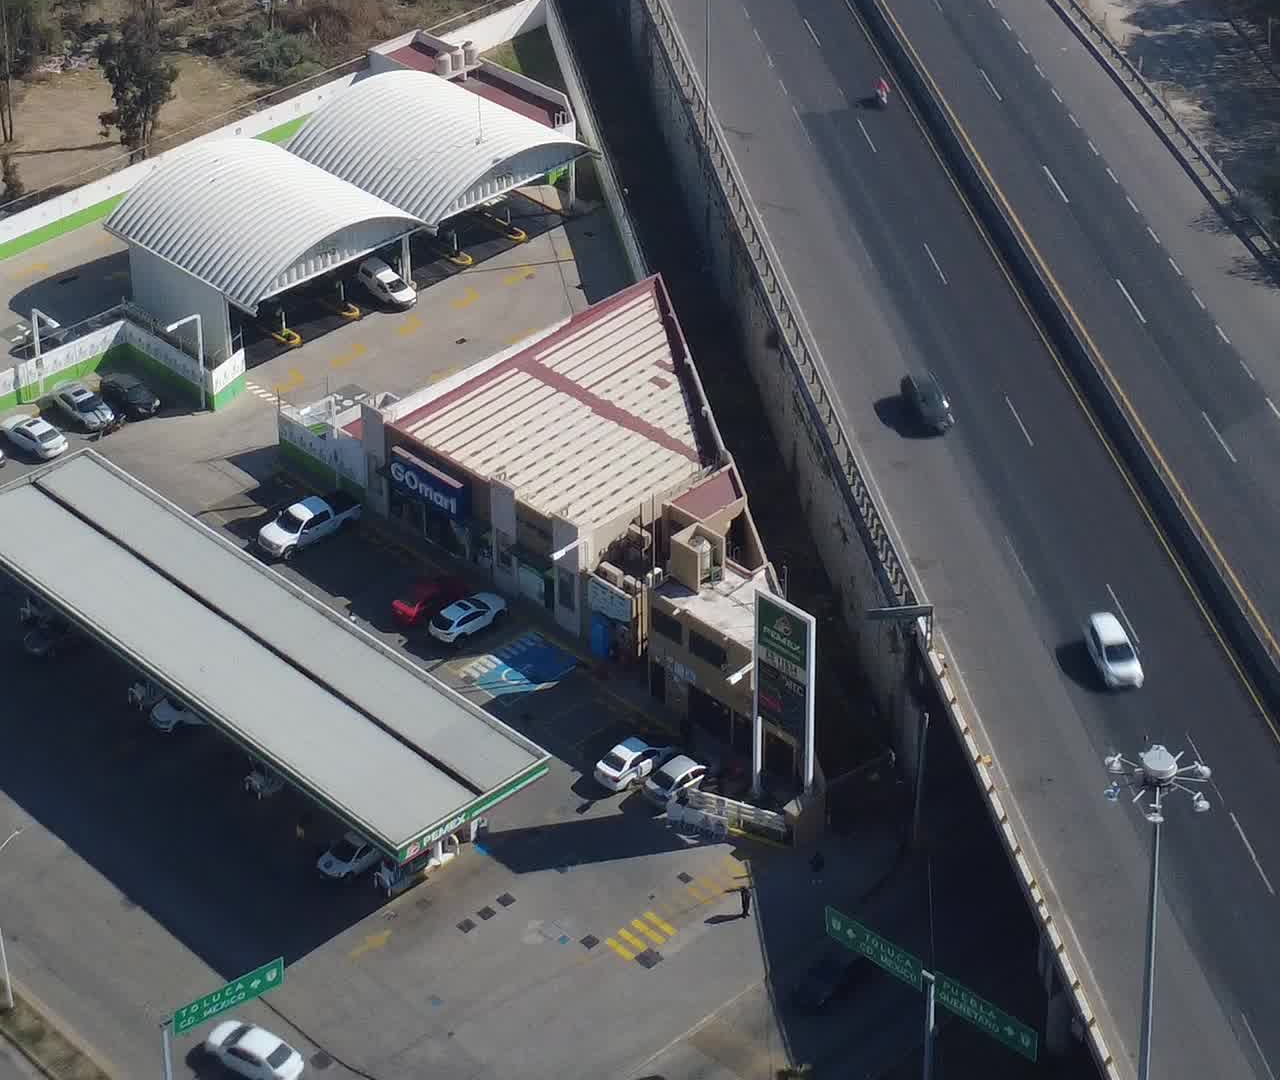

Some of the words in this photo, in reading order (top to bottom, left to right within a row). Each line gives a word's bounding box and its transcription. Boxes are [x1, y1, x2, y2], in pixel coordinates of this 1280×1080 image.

[423, 812, 466, 846] PEMEX
[863, 934, 913, 969] TOLUCA
[180, 981, 245, 1017] TOLUCA
[203, 992, 246, 1018] MEXICO
[942, 980, 998, 1020] PUEBLA
